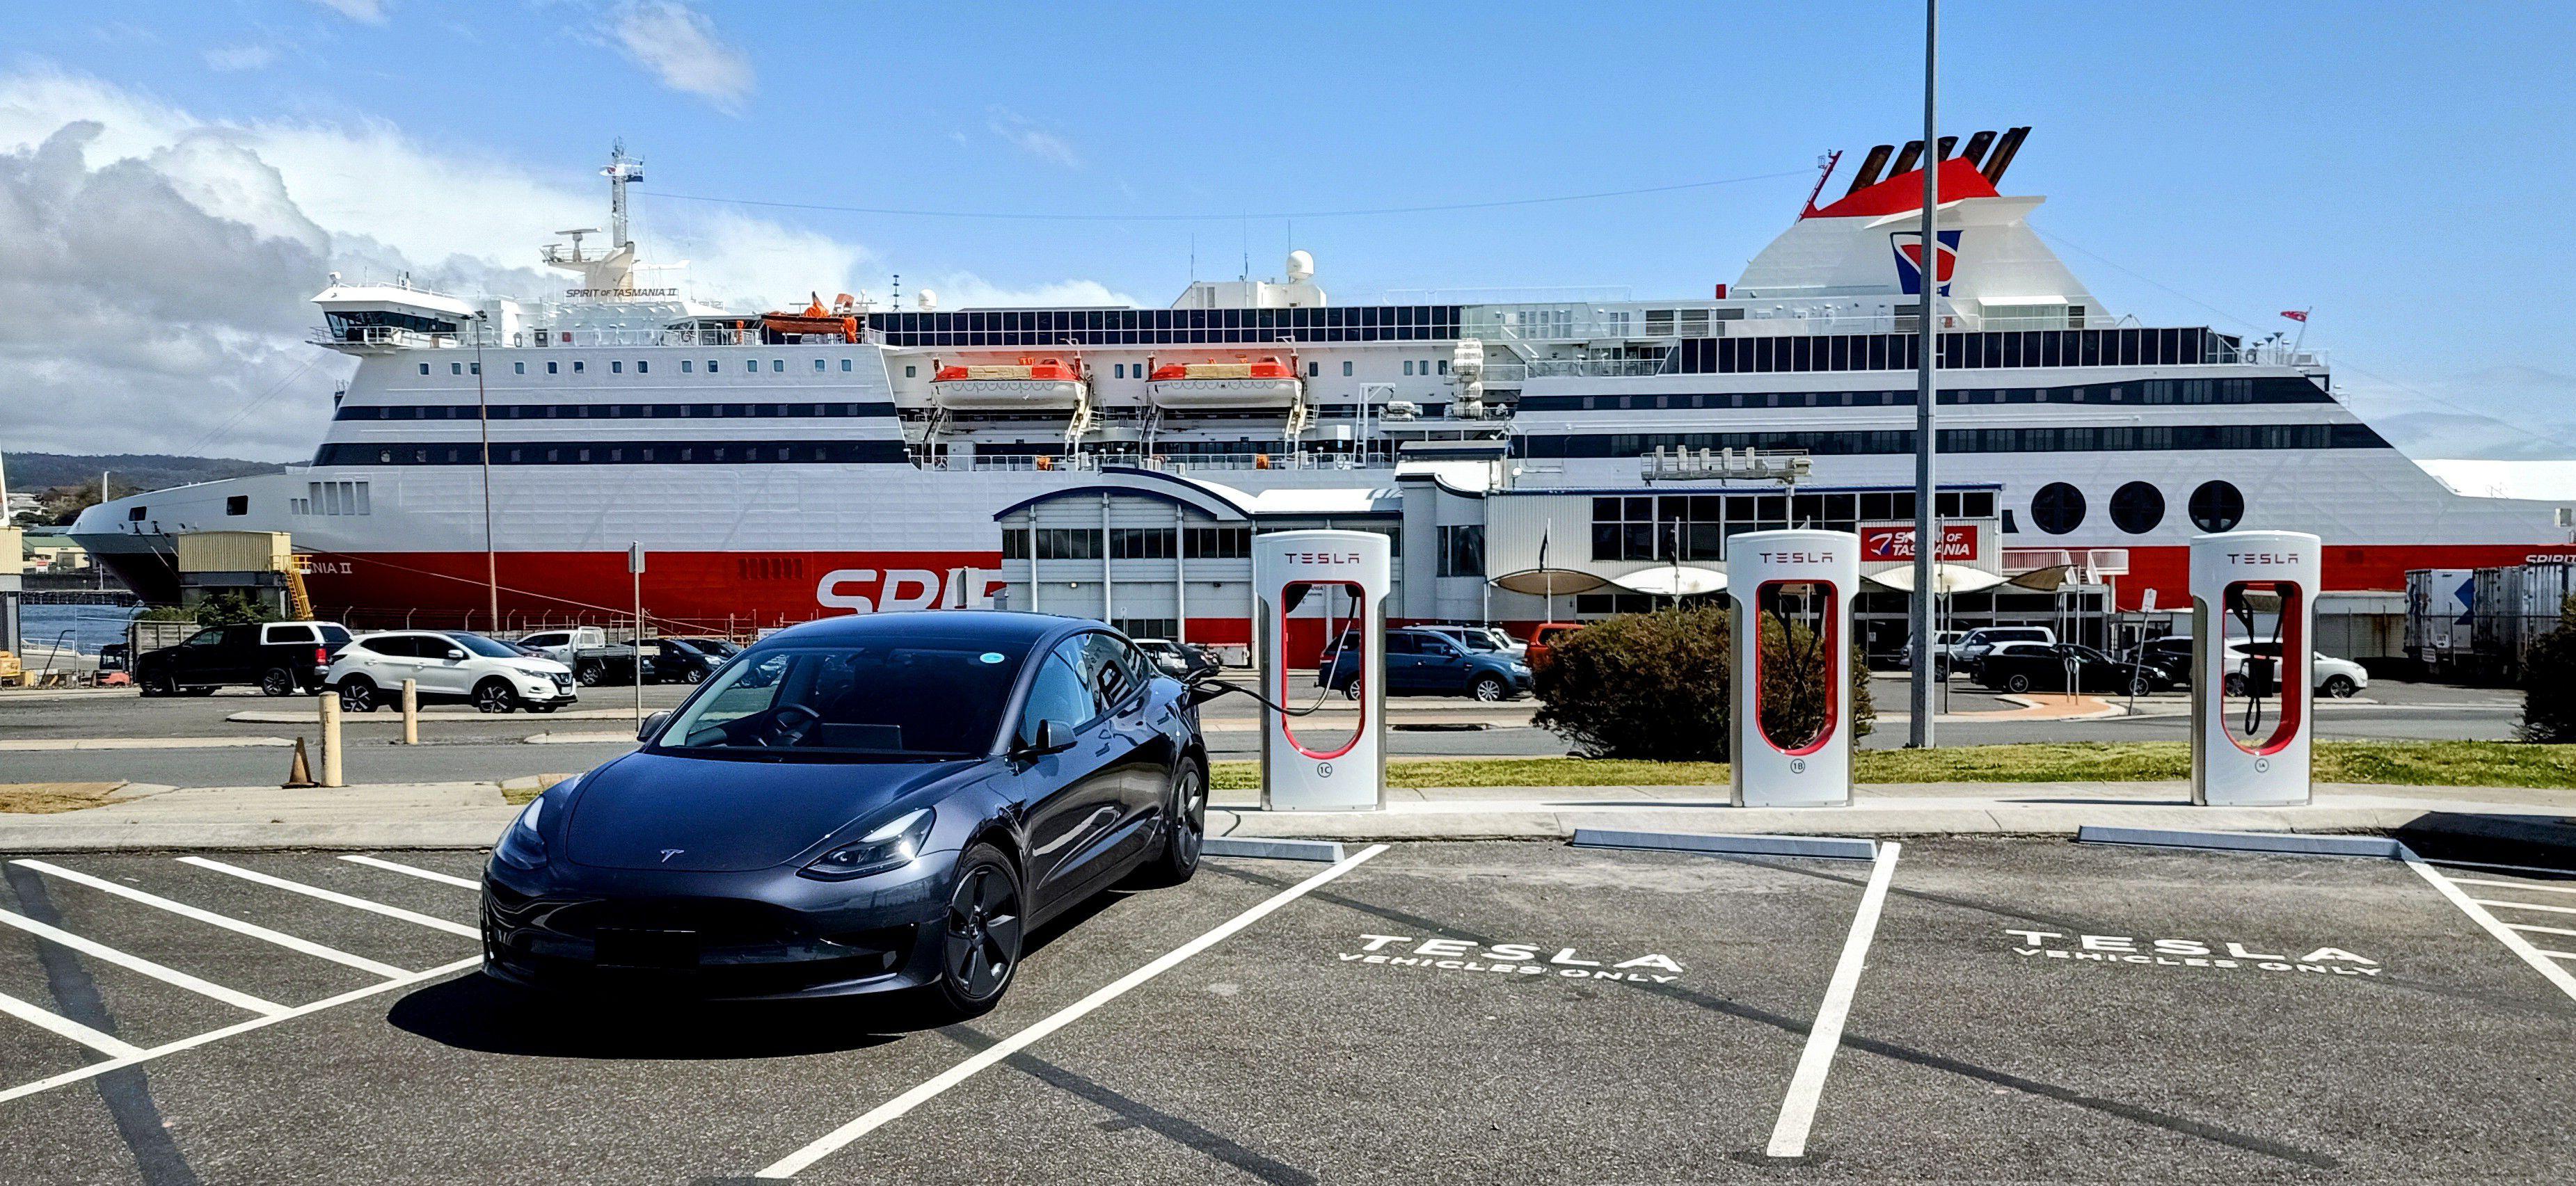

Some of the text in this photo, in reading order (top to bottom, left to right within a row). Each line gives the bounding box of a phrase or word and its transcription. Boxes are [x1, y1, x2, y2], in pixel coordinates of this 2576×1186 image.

[566, 289, 599, 297] SPIRIT
[613, 288, 665, 297] TASMANIA
[667, 288, 678, 296] II
[1946, 533, 1964, 543] OF
[1285, 553, 1360, 564] TESLA
[1759, 552, 1833, 563] TESLA
[2227, 553, 2298, 564] TESLA
[340, 562, 353, 574] II
[1360, 933, 1684, 972] TESLA
[2005, 929, 2378, 965] TESLA
[2012, 947, 2382, 976] VEHICLES ONLY
[1338, 952, 1678, 984] VEHICLES ONLY
